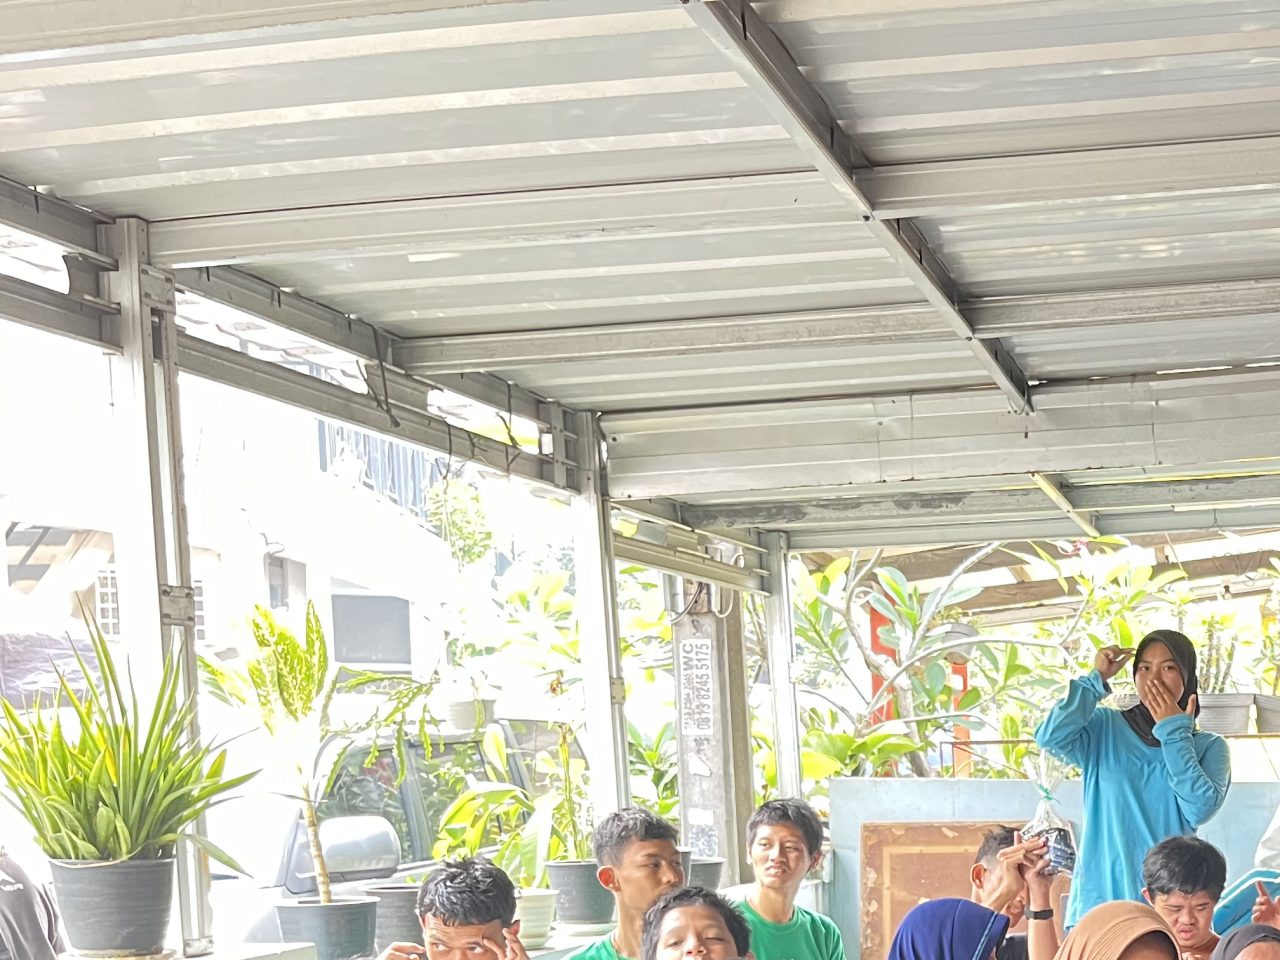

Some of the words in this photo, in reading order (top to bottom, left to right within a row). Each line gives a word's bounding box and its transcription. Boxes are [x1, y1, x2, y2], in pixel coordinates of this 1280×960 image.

[682, 643, 693, 671] WC
[694, 643, 710, 671] 5175
[695, 673, 711, 701] 8245
